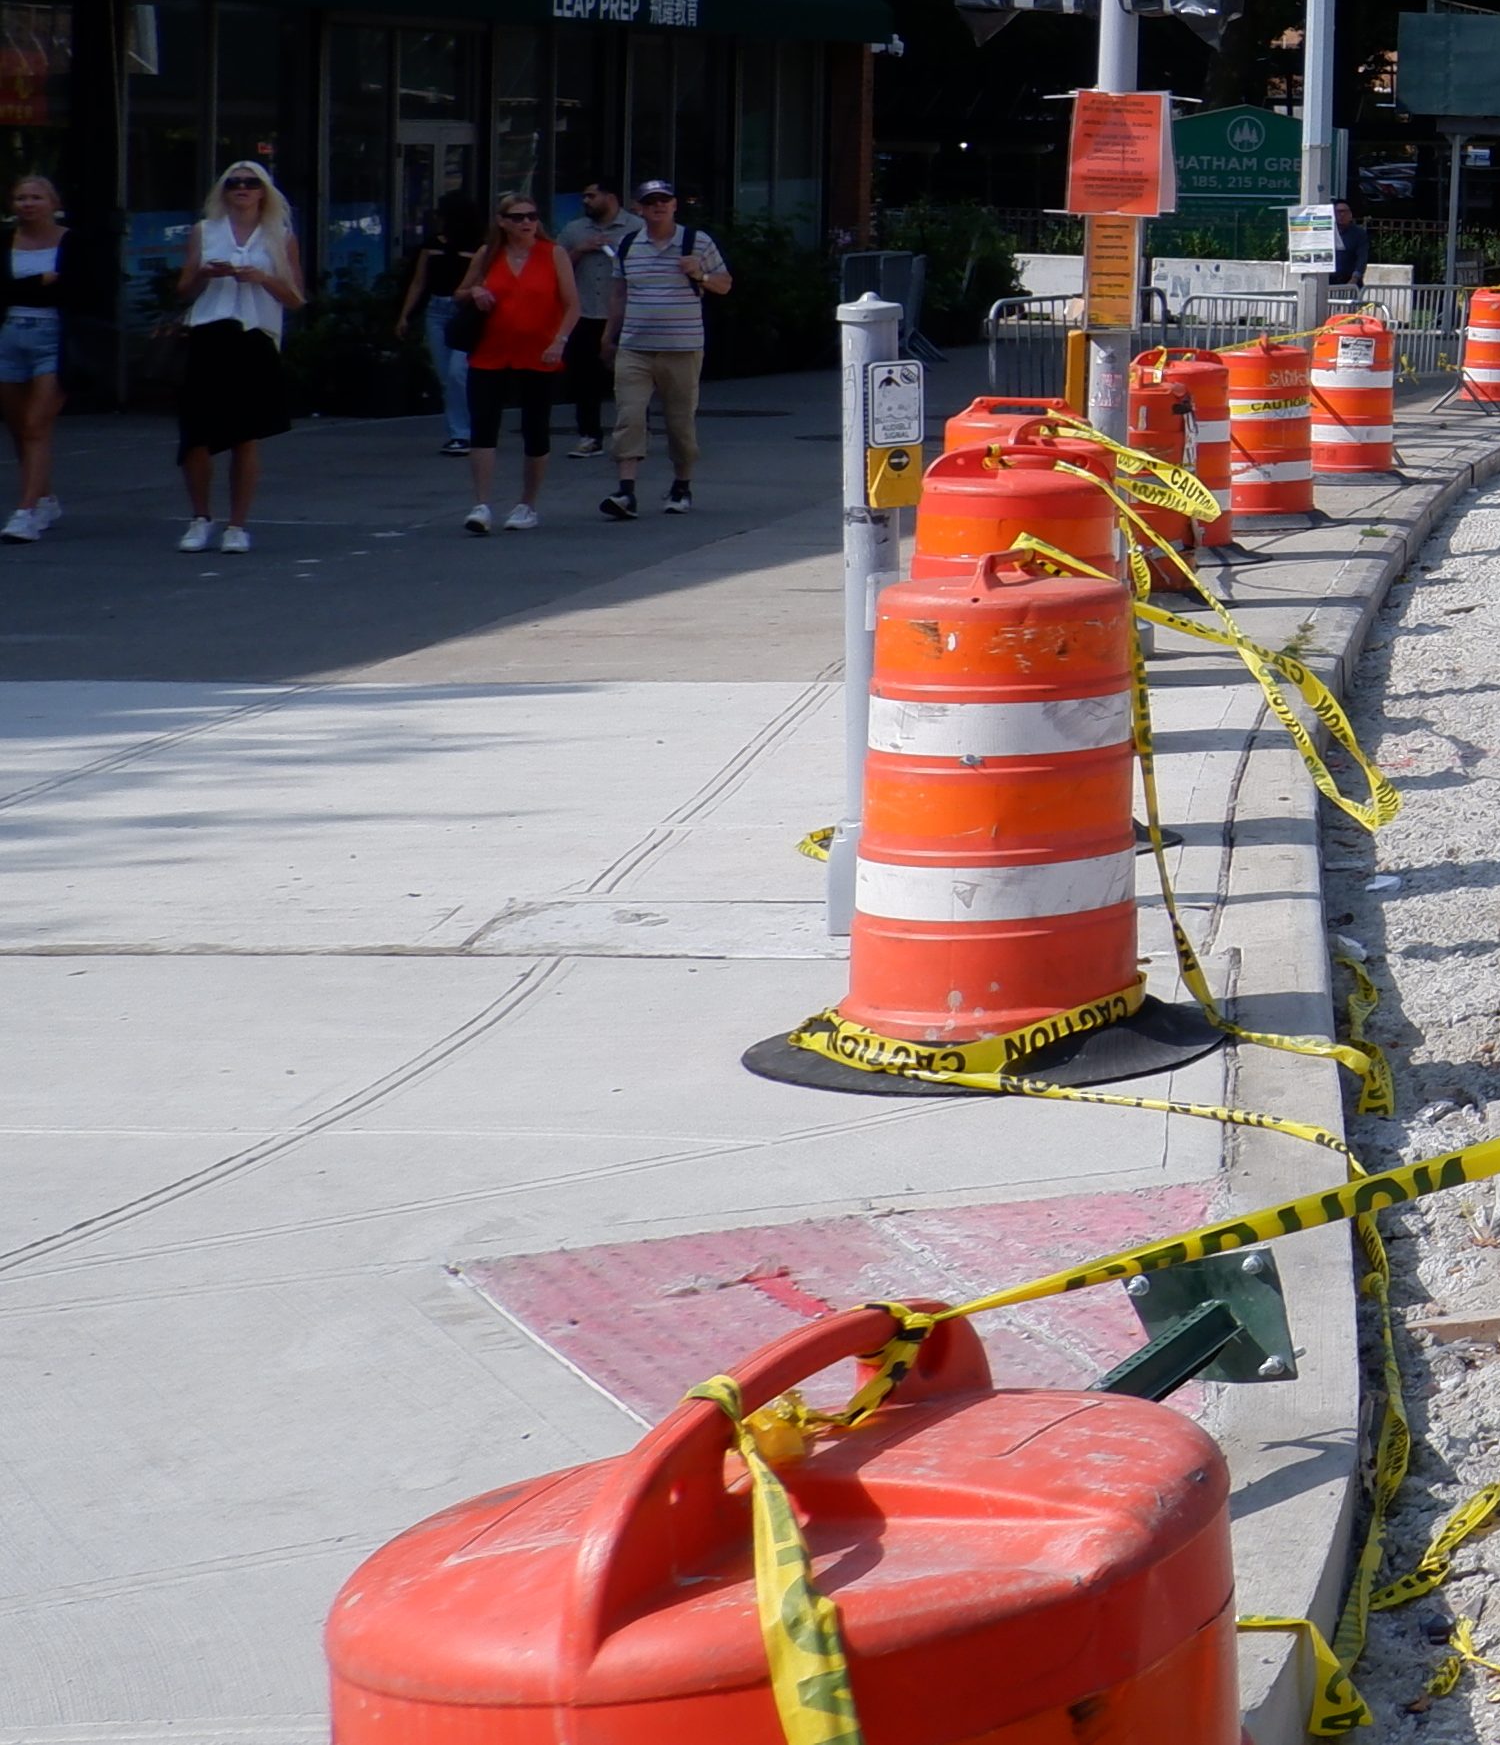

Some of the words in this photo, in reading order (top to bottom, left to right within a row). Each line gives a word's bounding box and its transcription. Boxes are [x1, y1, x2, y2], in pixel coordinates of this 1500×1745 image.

[1175, 156, 1257, 172] HATHAM
[1264, 158, 1300, 172] GRE
[1258, 177, 1292, 188] Park
[1251, 398, 1308, 411] CAUTION
